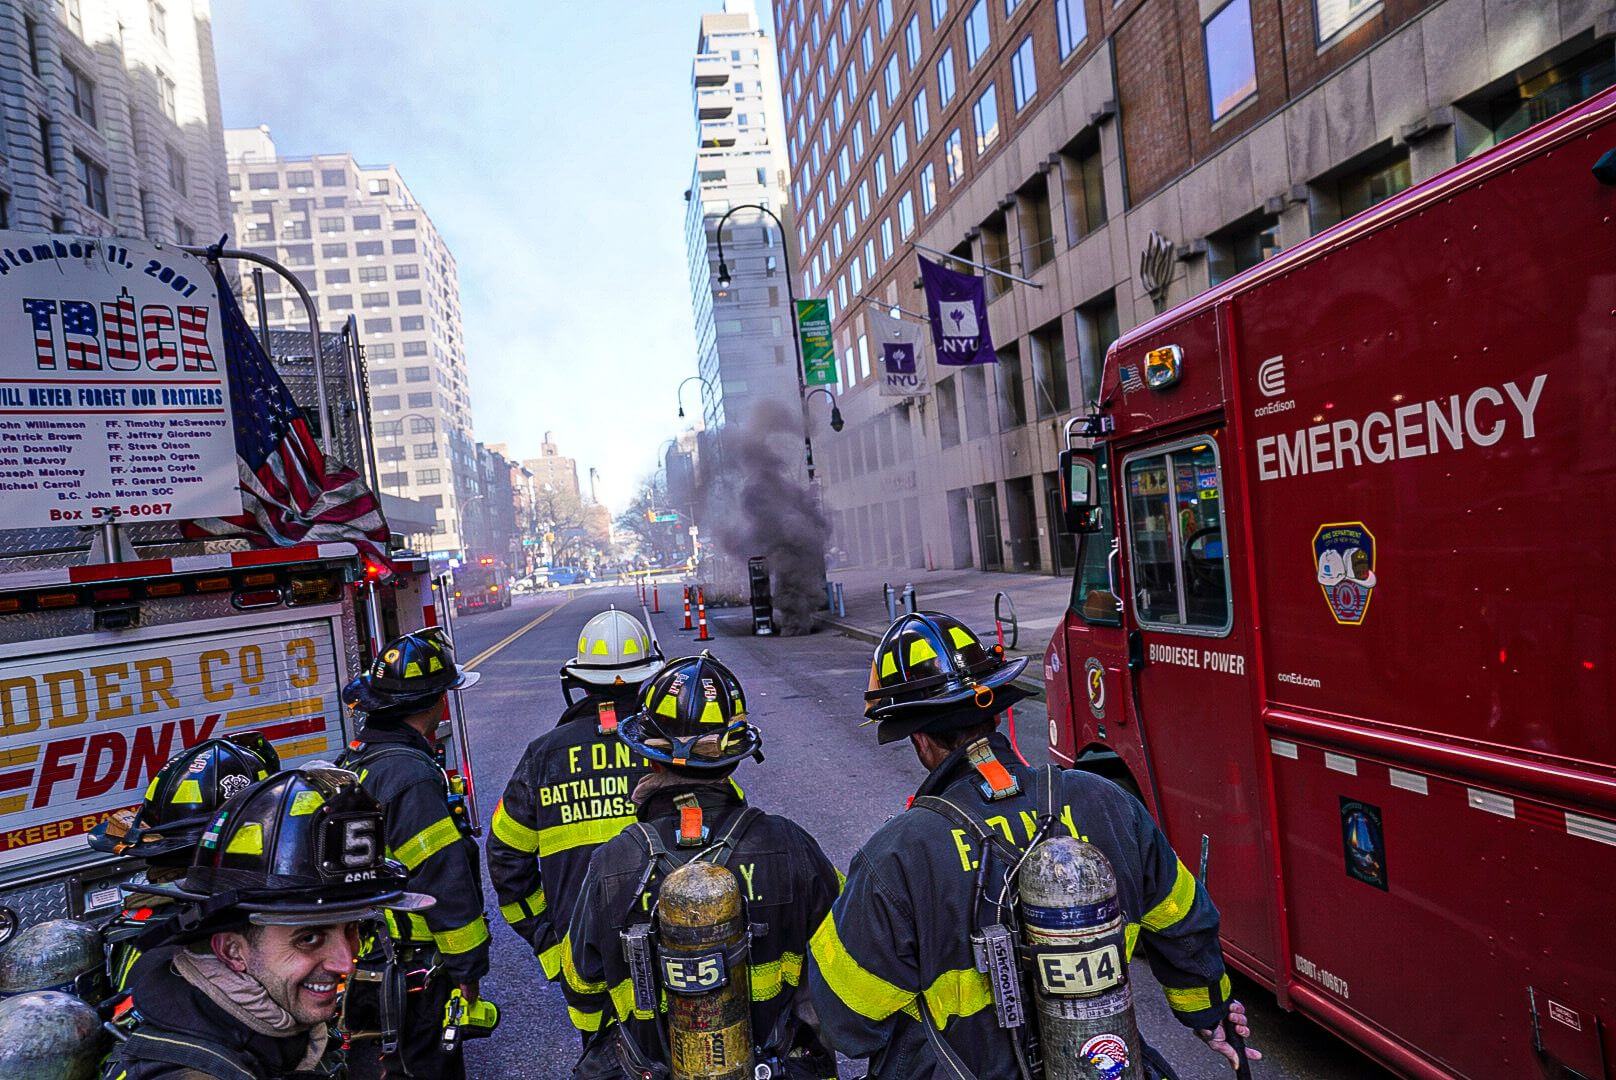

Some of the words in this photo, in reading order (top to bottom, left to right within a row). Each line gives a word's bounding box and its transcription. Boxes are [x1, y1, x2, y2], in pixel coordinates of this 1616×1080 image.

[144, 260, 198, 298] 2001
[23, 287, 217, 371] TRUCK
[942, 338, 979, 352] NYU
[887, 374, 918, 386] NYU
[0, 388, 23, 406] ILL
[28, 388, 72, 406] NEVER
[78, 388, 126, 406] FORGET
[131, 388, 156, 406] OUR
[162, 388, 223, 406] BROTHERS
[1254, 399, 1295, 417] conEdison
[25, 421, 86, 429] Williamson
[105, 420, 121, 428] FF.
[125, 420, 165, 428] Timothy
[169, 419, 227, 428] McSweeney
[1257, 374, 1548, 480] EMERGENCY
[2, 433, 43, 441] Patrick
[48, 432, 82, 440] Brown
[127, 431, 163, 440] Jeffrey
[0, 445, 18, 453] vin
[23, 445, 72, 453] Donnelly
[108, 443, 123, 451] FF.
[161, 442, 190, 450] Olson
[23, 457, 66, 465] McAvoy
[129, 454, 166, 462] Joseph
[170, 453, 200, 461] Ogren
[130, 465, 163, 473] James
[167, 464, 195, 472] Coyle
[43, 480, 80, 488] Carroll
[112, 478, 127, 486] FF.
[131, 477, 166, 485] Gerard
[170, 476, 203, 484] Dewan
[58, 491, 81, 500] B.C.
[85, 491, 111, 499] John
[116, 489, 148, 497] Moran
[152, 487, 174, 495] SOC
[49, 508, 83, 521] Box
[91, 503, 172, 519] 55-8087
[287, 637, 319, 688] 3
[1150, 643, 1200, 668] BIODIESEL
[1203, 650, 1245, 675] POWER
[1278, 672, 1321, 688] conEd.com
[540, 776, 628, 807] BATTALION
[7, 820, 74, 849] KEEP
[344, 820, 375, 867] 5
[666, 959, 719, 988] E-5
[1042, 952, 1115, 988] E-14
